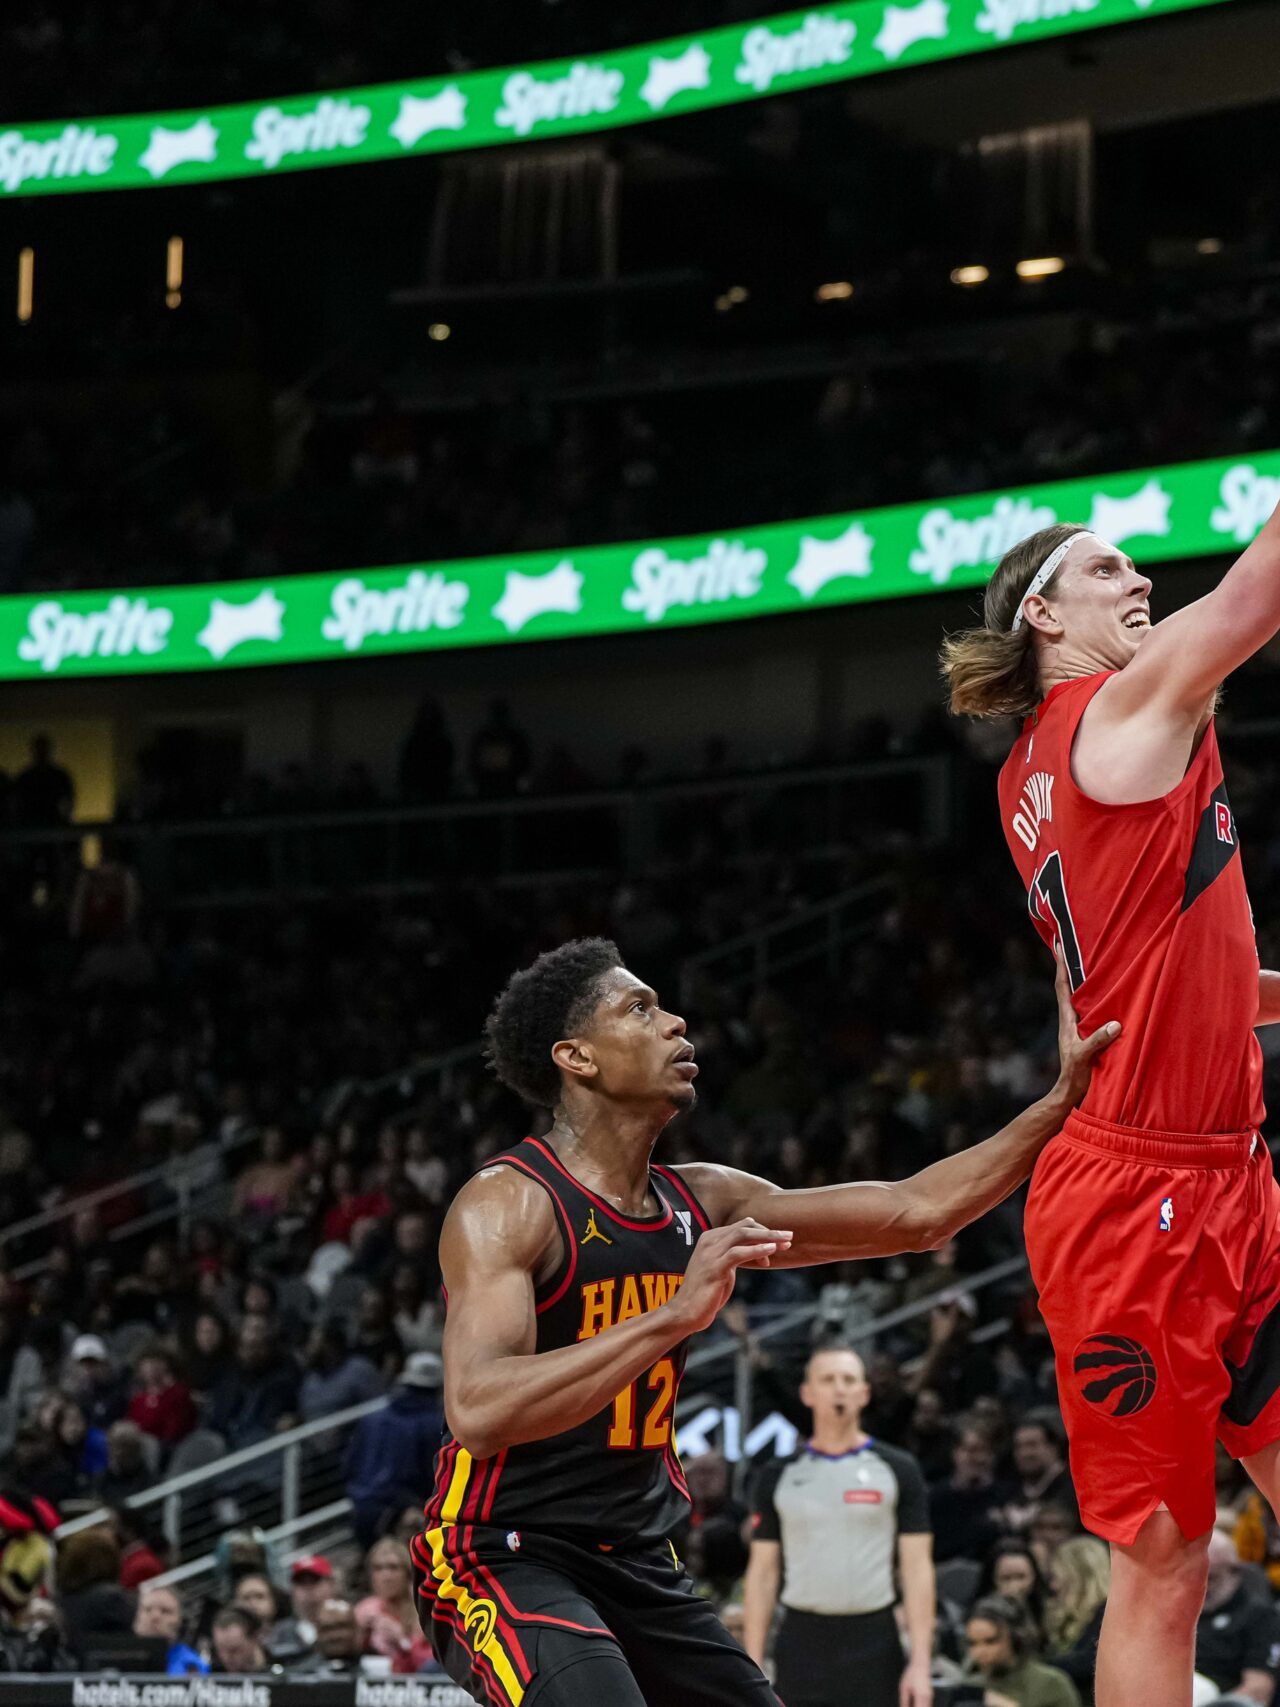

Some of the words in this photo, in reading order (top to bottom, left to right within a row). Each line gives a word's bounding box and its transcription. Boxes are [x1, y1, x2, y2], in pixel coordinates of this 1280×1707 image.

[244, 98, 371, 168] Sprite
[494, 63, 624, 135] Sprite
[734, 14, 857, 91] Sprite
[18, 596, 173, 671] Sprite
[321, 570, 470, 651] Sprite
[621, 539, 768, 622] Sprite
[607, 1356, 677, 1450] 12
[675, 1406, 800, 1463] KIA
